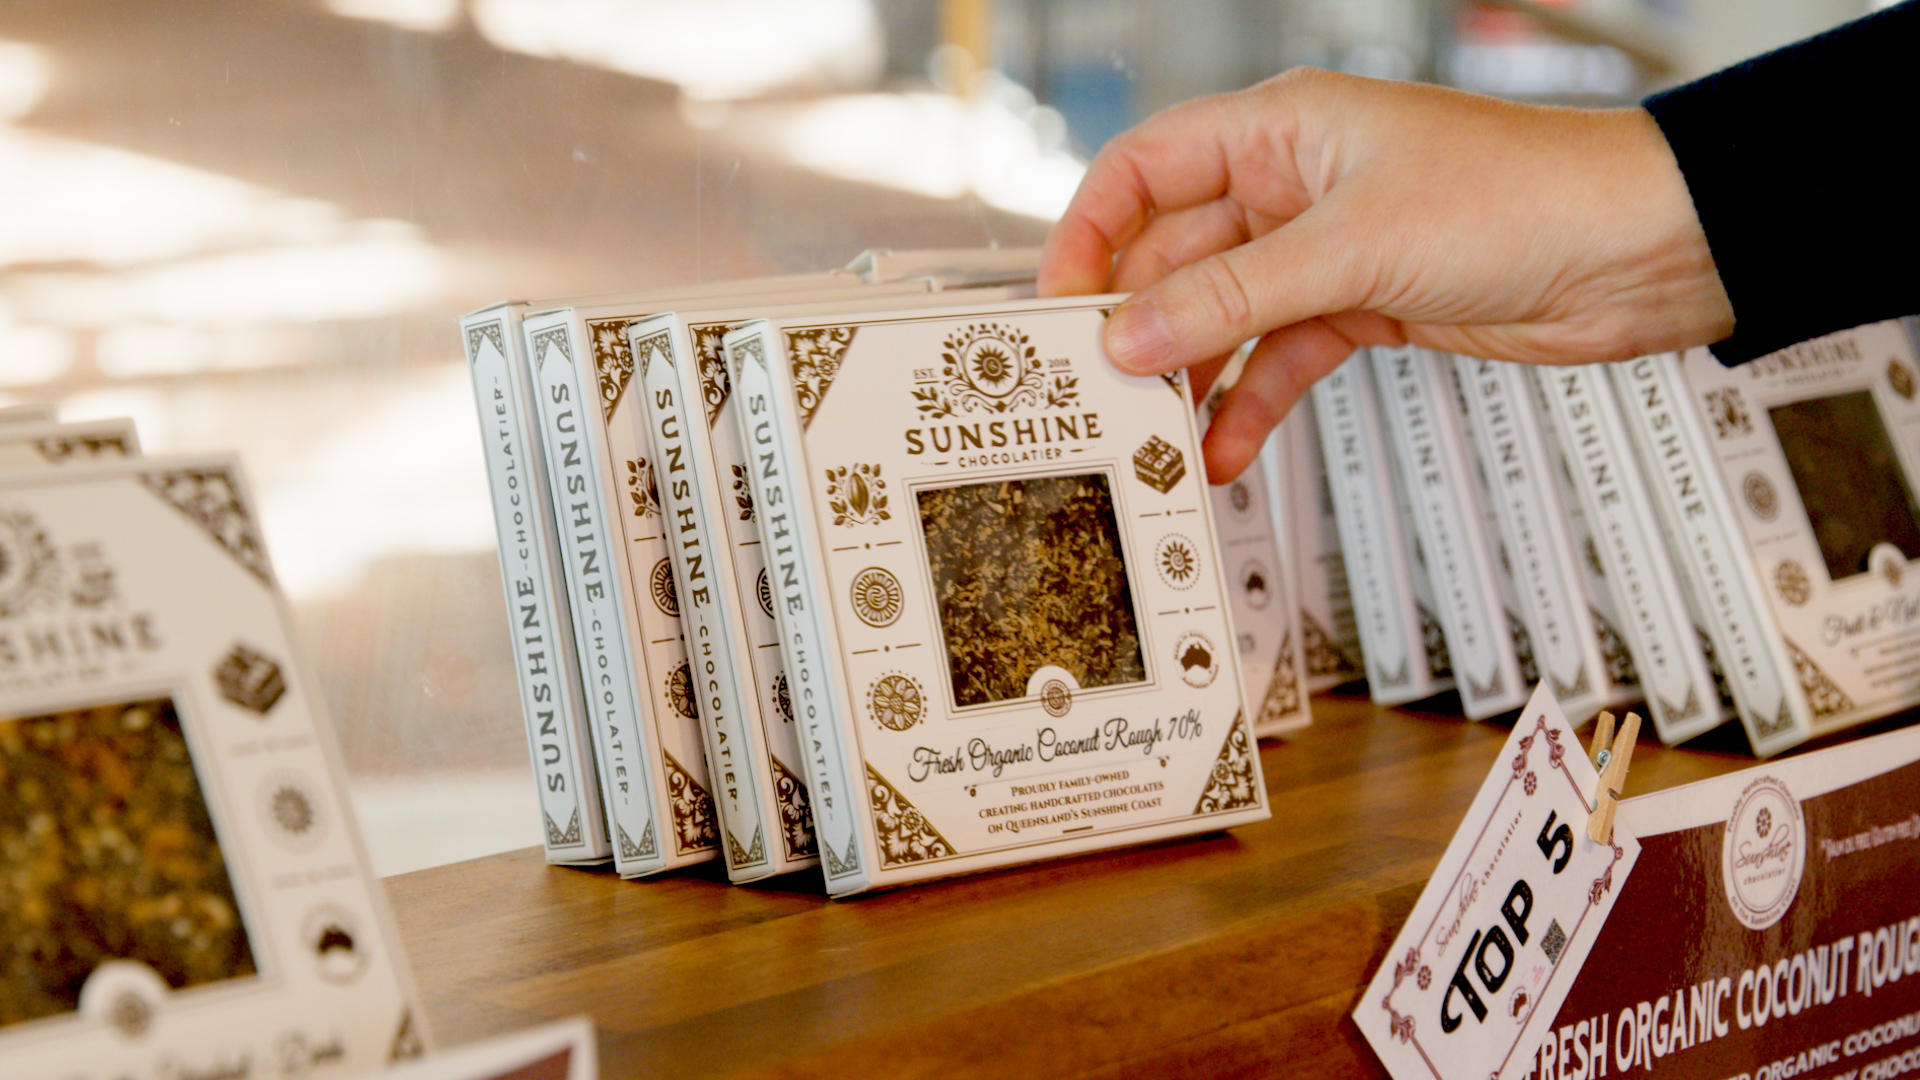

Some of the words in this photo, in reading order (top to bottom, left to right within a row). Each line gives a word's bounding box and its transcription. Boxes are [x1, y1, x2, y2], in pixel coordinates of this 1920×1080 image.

[913, 366, 937, 381] EST.
[1047, 357, 1071, 369] 2018
[905, 413, 1103, 456] SUNSHINE
[958, 447, 1062, 469] CHOCOLATIER
[1329, 373, 1362, 476] SHINE
[1394, 355, 1442, 486] NSHINE
[1477, 359, 1524, 486] NSHINE
[1560, 373, 1621, 508] NSHINE
[1632, 359, 1705, 521] UNSHINE
[551, 383, 605, 604] SUNSHINE
[655, 388, 711, 609] SUNSHINE
[749, 393, 804, 616] SUNSHINE
[516, 575, 566, 793] SUNSHINE
[908, 746, 964, 783] Fresh
[968, 738, 1034, 778] Organic
[1037, 727, 1100, 762] Coconut
[1104, 717, 1163, 756] Rough
[1167, 709, 1203, 742] 70%
[979, 803, 1028, 819] CREATING
[1029, 791, 1101, 812] HANDCRAFTED
[1102, 781, 1165, 800] CHOCOLATES
[987, 823, 1003, 834] ON
[1131, 797, 1162, 811] COAST
[1481, 809, 1523, 886] chocolatier
[1735, 823, 1792, 869] Sunshine
[1743, 867, 1786, 886] chocolatier
[1440, 878, 1534, 1035] TOP
[1536, 808, 1574, 875] 5
[1615, 976, 1731, 1073] ORGANIC
[1736, 935, 1854, 1030] COCONUT
[1855, 915, 1920, 998] ROUG
[1755, 1039, 1841, 1080] ORGANIC
[1842, 1010, 1920, 1057] COCONU
[1859, 1046, 1920, 1080] CHOCO
